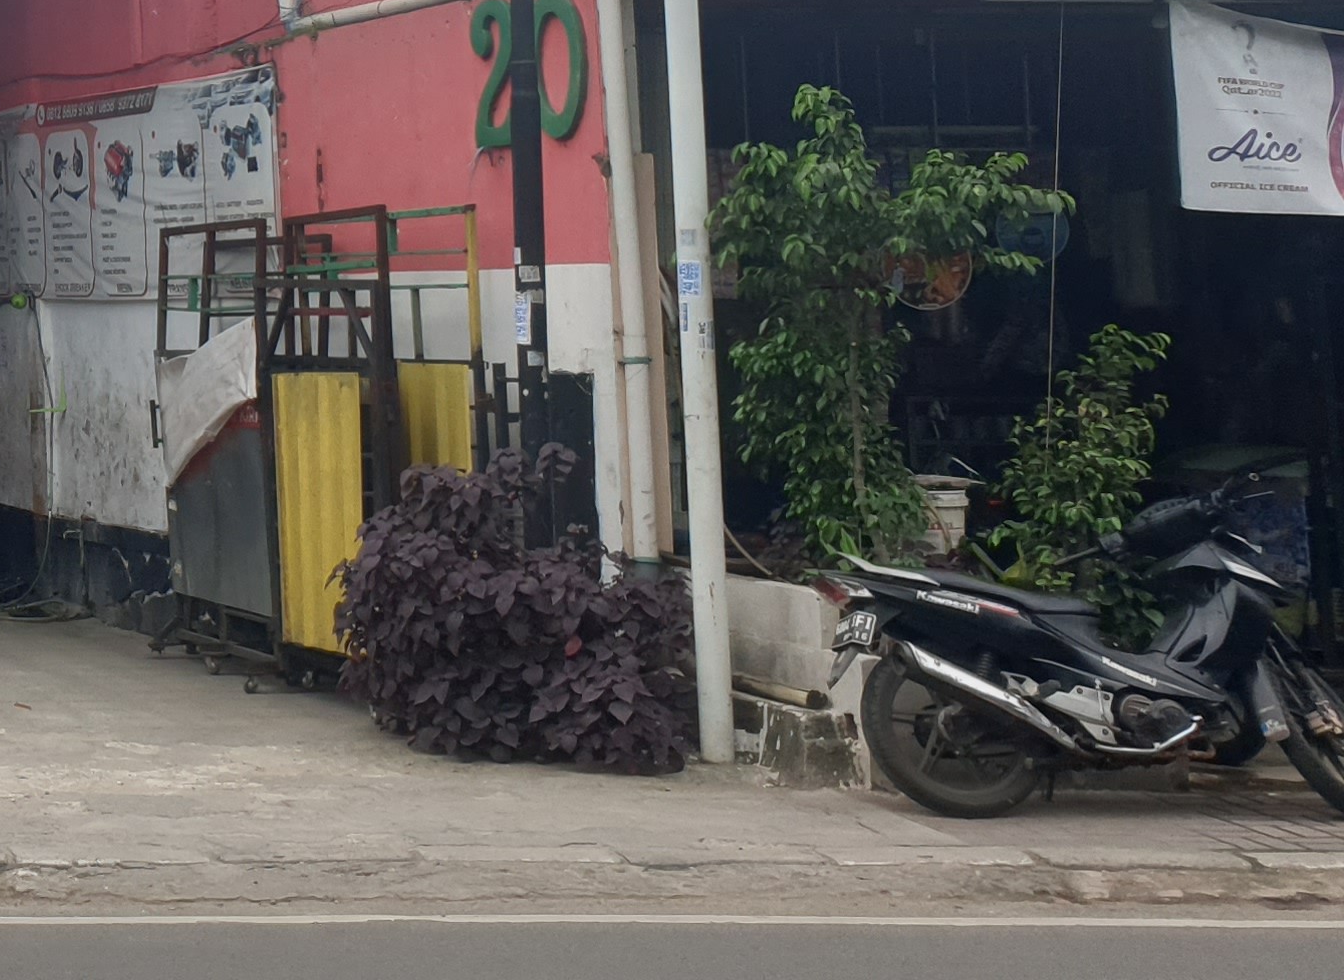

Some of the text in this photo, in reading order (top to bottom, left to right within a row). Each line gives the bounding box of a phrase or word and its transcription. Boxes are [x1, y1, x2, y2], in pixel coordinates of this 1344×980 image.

[1218, 77, 1238, 85] FIFA
[1208, 129, 1301, 162] Aice
[1211, 182, 1308, 192] OFFICIAL ICE CREAM
[916, 590, 980, 615] Kawasaki
